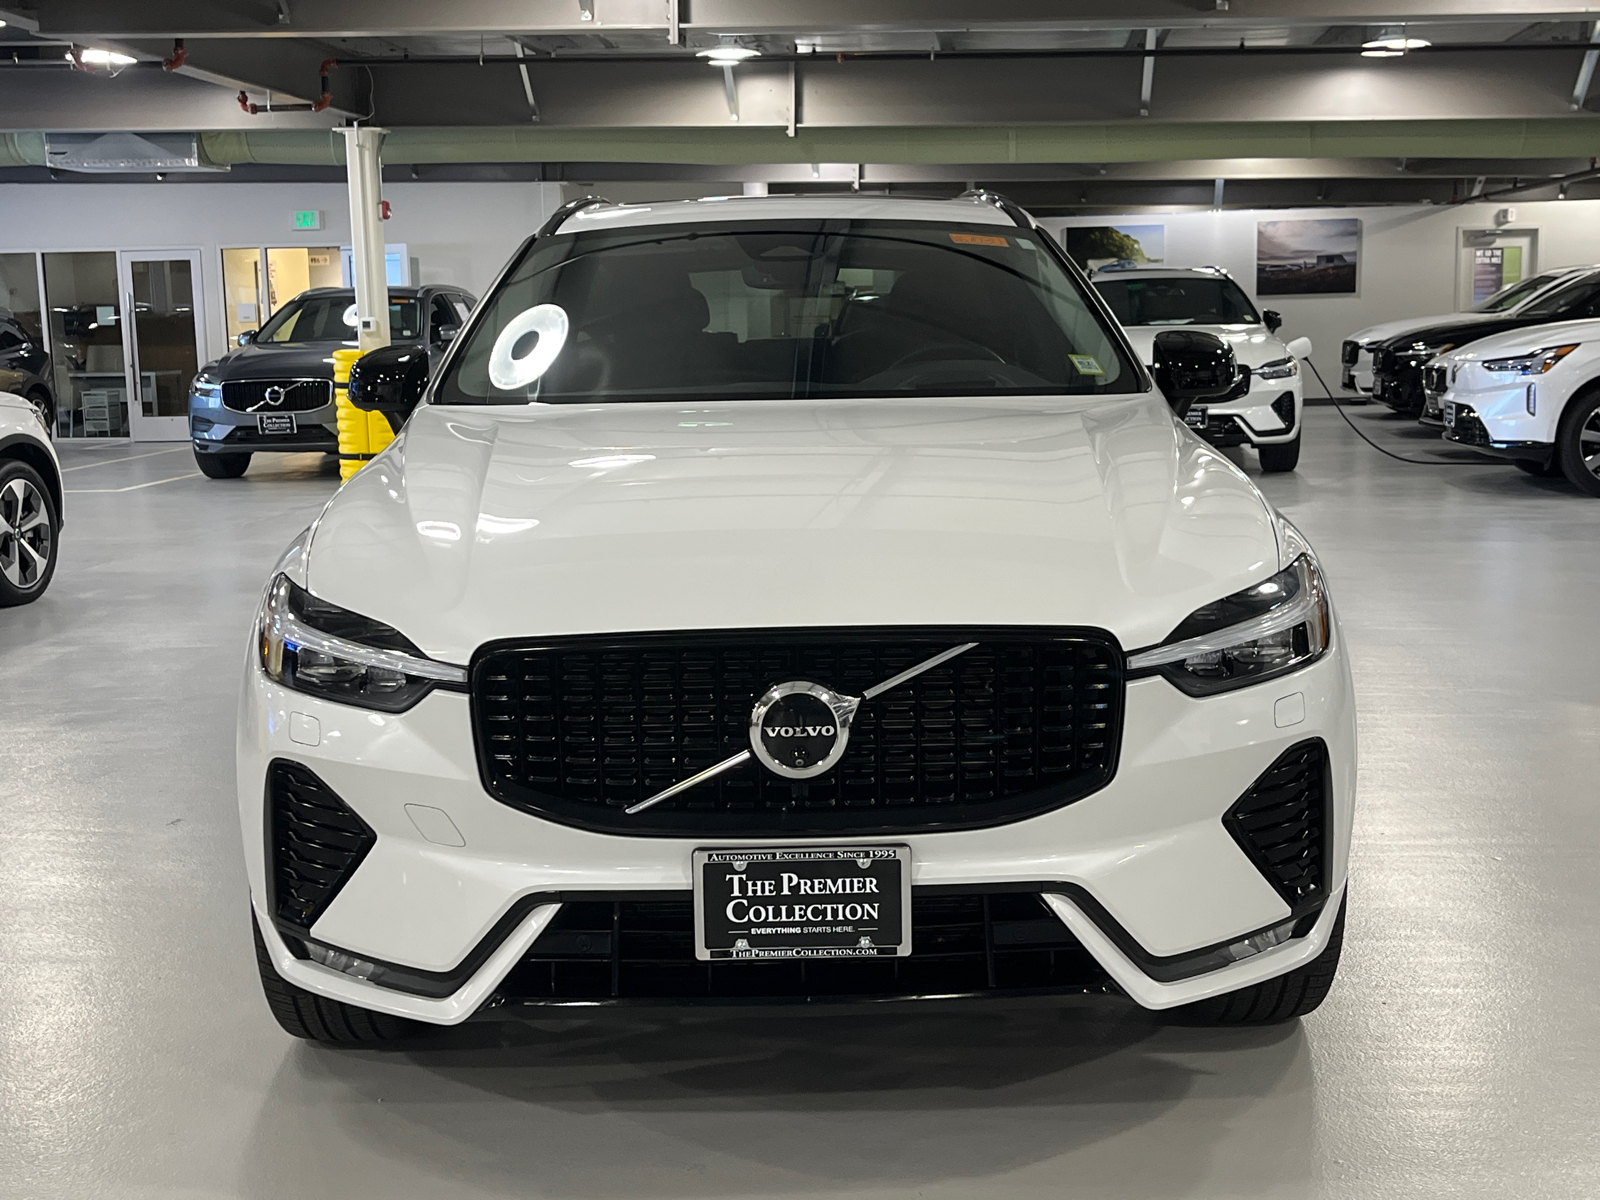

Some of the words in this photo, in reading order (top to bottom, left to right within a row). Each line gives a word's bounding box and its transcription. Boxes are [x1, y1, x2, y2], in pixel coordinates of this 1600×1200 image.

[296, 211, 315, 227] EXIT
[763, 724, 835, 737] VOLVO
[710, 852, 773, 861] AUTOMOTIVE
[775, 851, 835, 860] EXCELLENCE
[836, 850, 866, 859] SINCE
[868, 850, 895, 858] 1995
[726, 873, 776, 896] THE
[780, 873, 880, 895] PREMIER
[726, 899, 880, 923] COLLECTION
